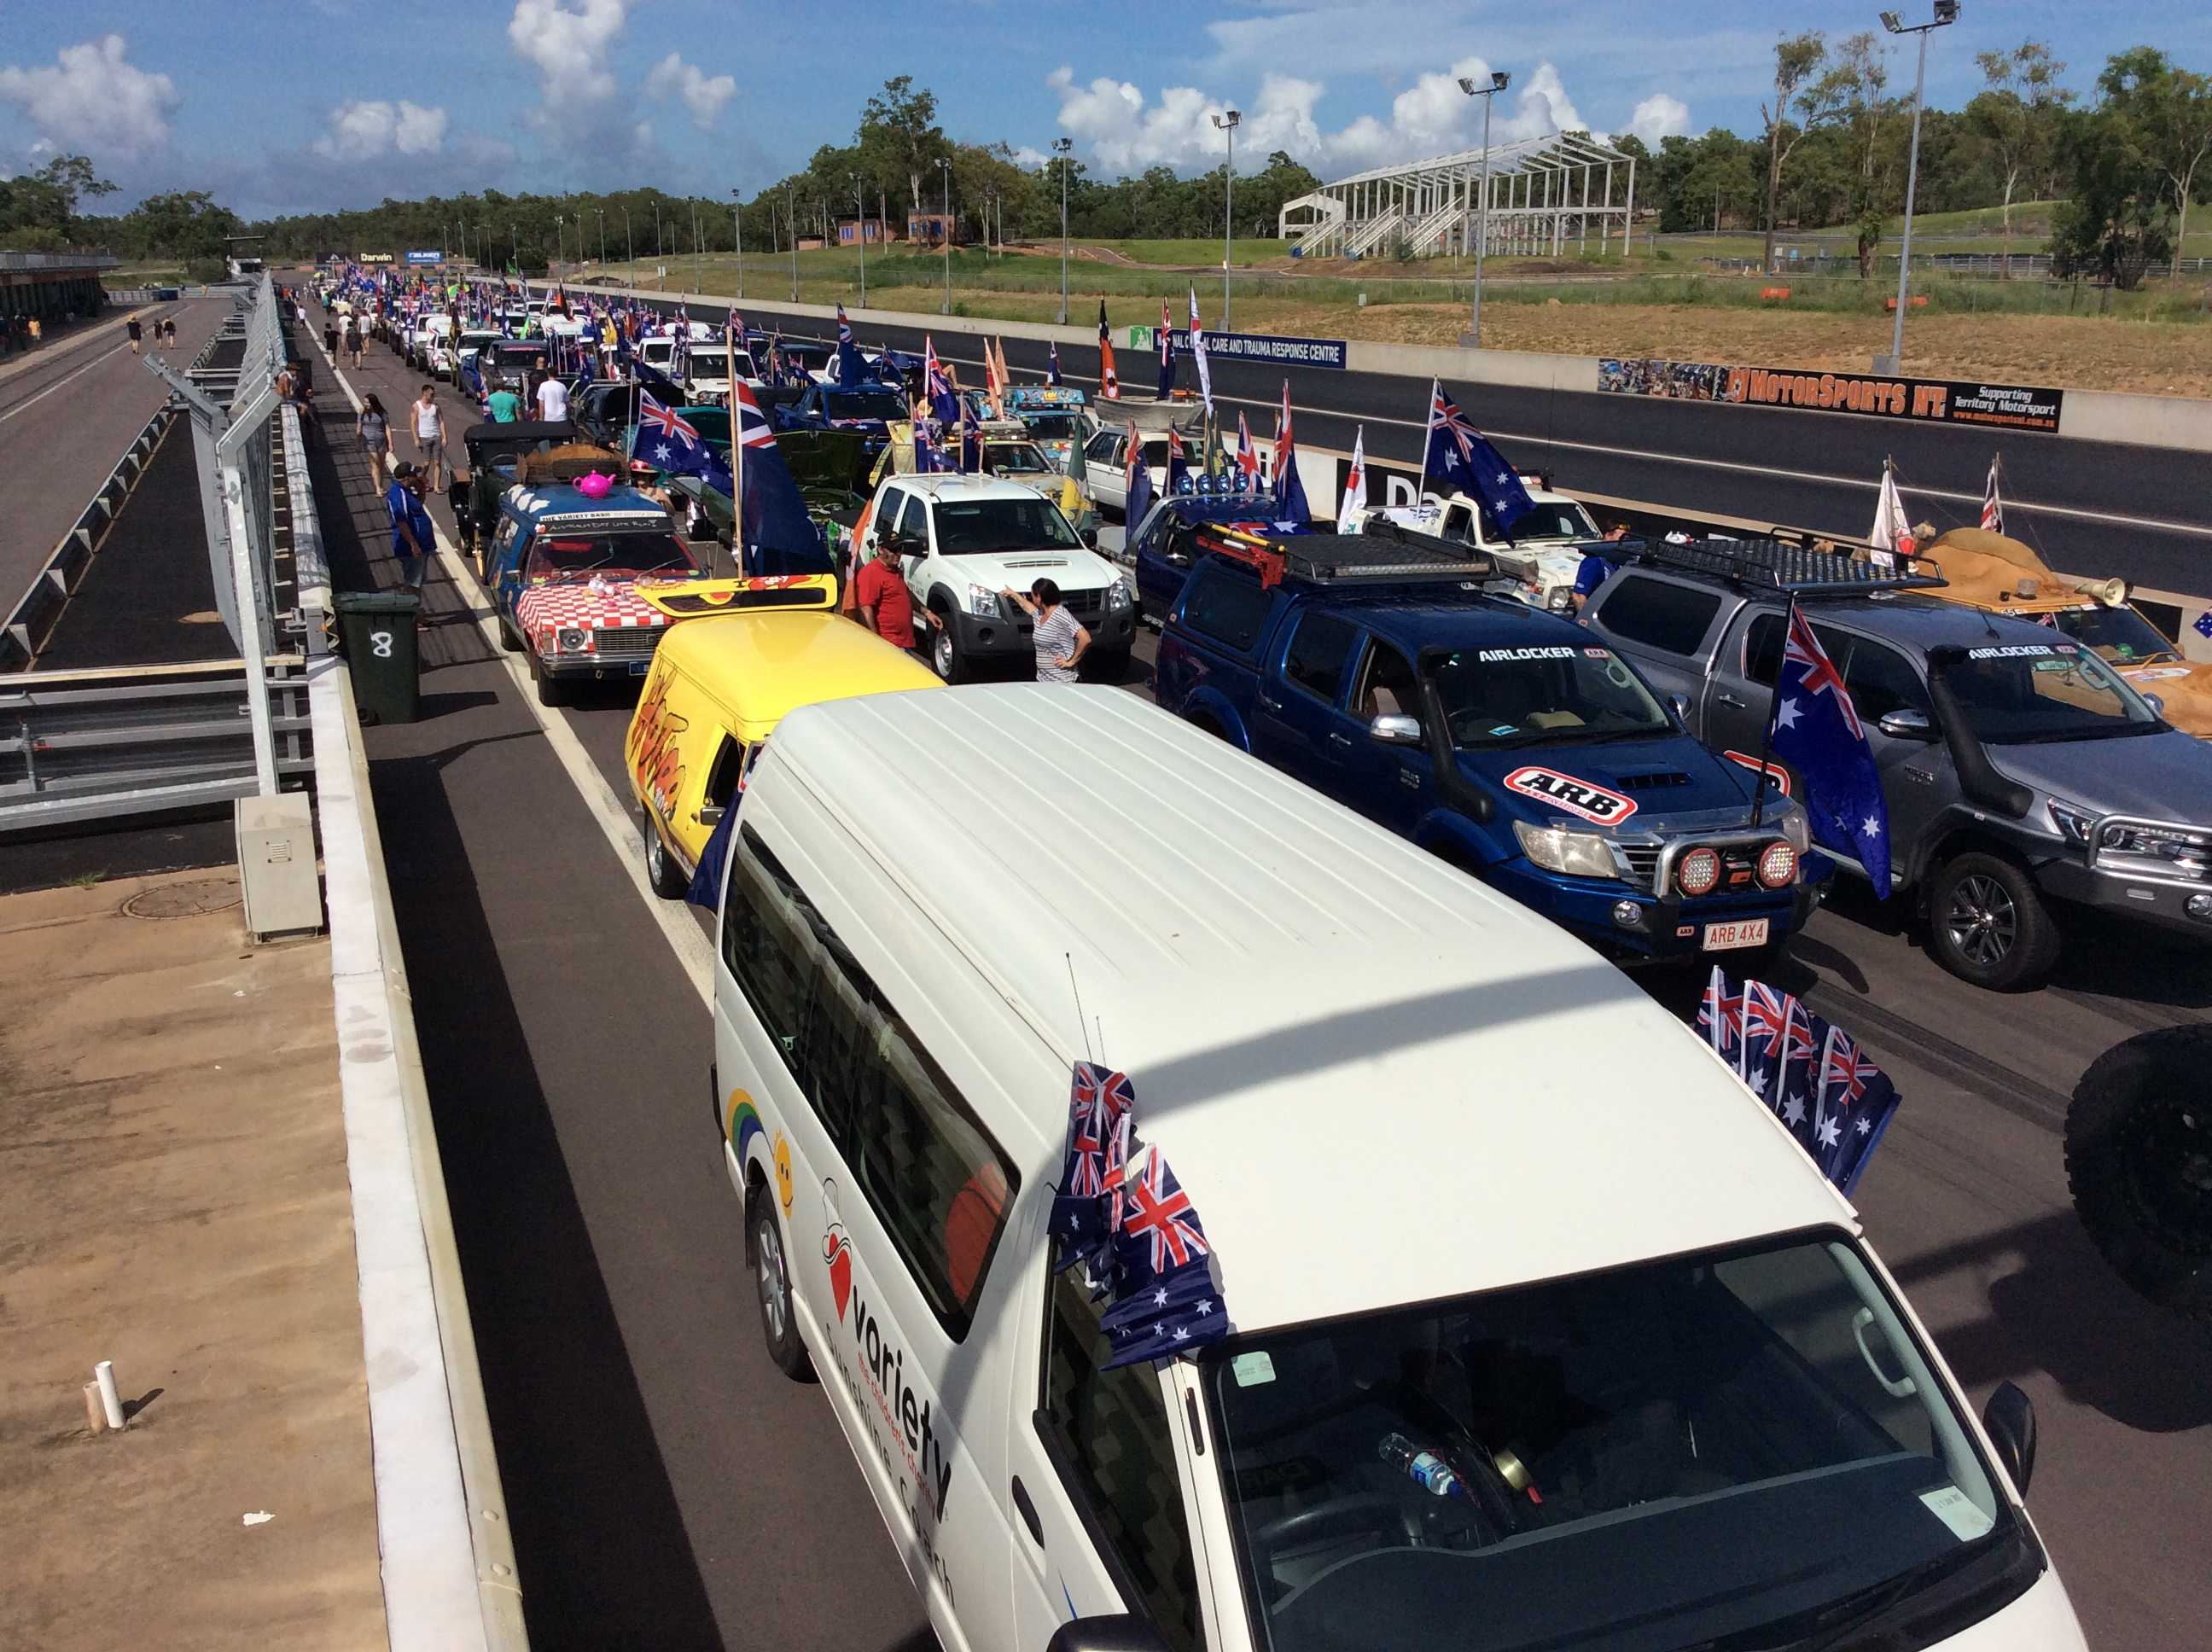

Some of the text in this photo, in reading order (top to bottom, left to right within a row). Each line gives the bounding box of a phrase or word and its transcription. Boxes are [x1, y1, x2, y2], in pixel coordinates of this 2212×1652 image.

[360, 253, 393, 261] Darwin
[1211, 340, 1228, 352] CARE
[1228, 341, 1243, 353] AND
[1243, 342, 1271, 357] TRAUMA
[1272, 345, 1309, 359] RESPONSE
[1309, 347, 1340, 362] CENTRE
[1912, 385, 1947, 417] NT
[1954, 396, 1996, 412] Territory
[1998, 399, 2055, 416] Motorsport
[1978, 387, 2034, 404] Supporting
[1479, 647, 1576, 662] AIRLOCKER
[1968, 645, 2055, 660] AIRLOCKER
[1518, 773, 1621, 816] ARB
[1709, 923, 1763, 944] ARB 4X4
[853, 1285, 952, 1525] variety
[857, 1351, 935, 1521] the children's charity
[825, 1322, 956, 1611] Sunshine Coach
